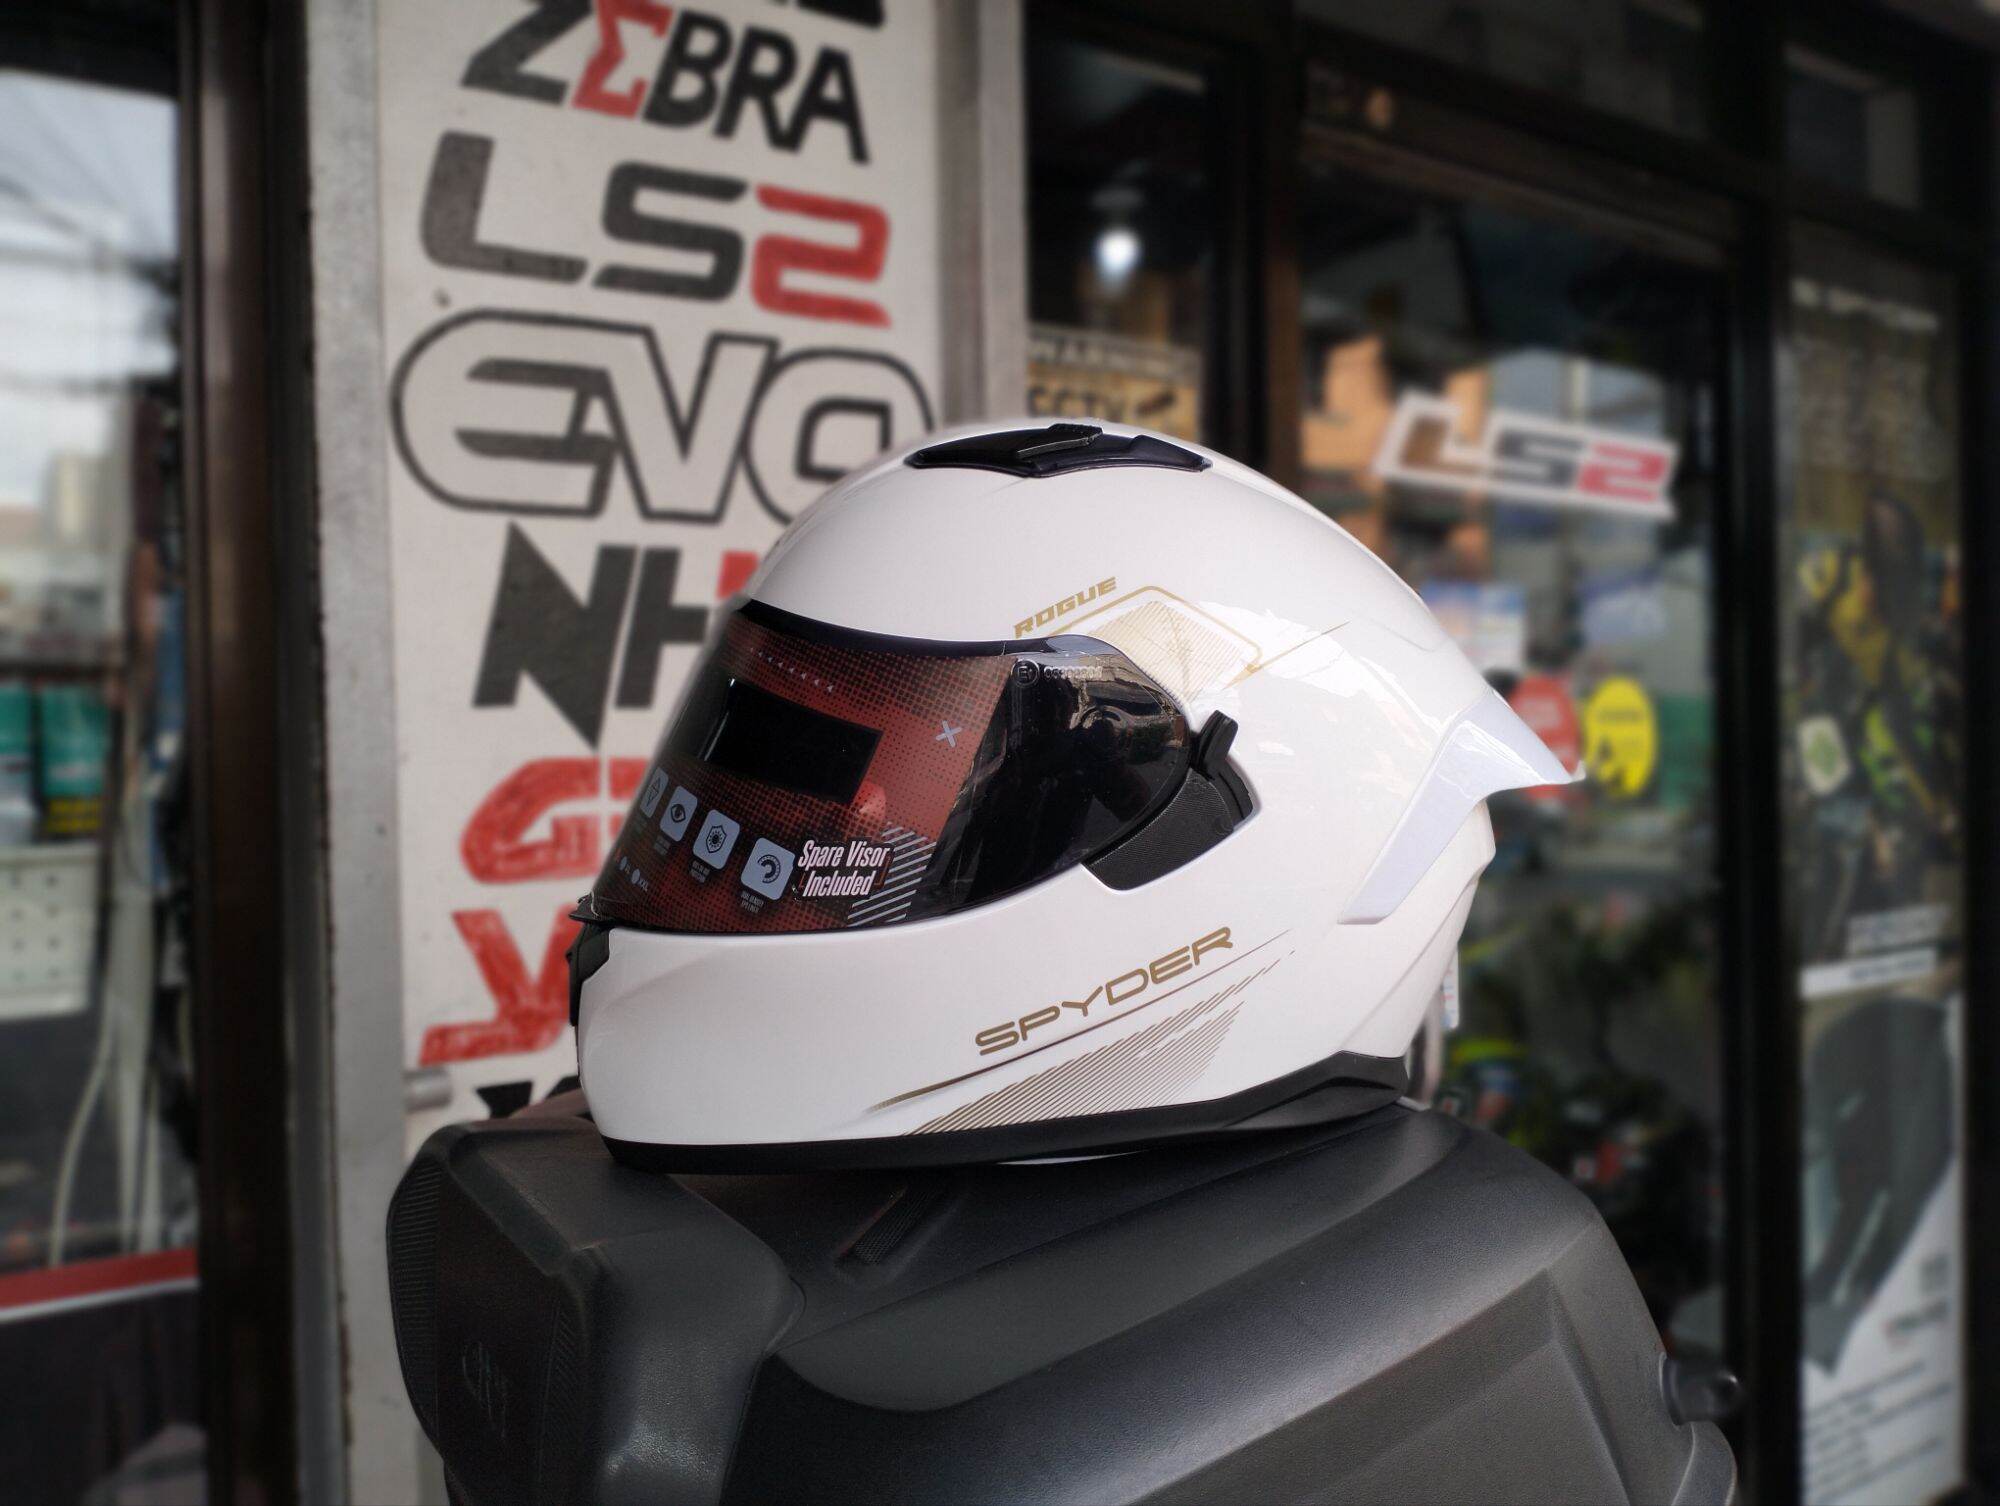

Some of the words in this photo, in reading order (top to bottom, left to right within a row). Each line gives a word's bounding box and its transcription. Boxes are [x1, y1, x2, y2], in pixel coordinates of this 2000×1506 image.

[420, 130, 892, 328] LS2
[391, 308, 935, 526] EVO
[1388, 402, 1675, 510] LS2
[471, 521, 762, 751] NH
[1014, 577, 1116, 638] ROGUE
[797, 840, 845, 871] Spare
[846, 840, 890, 868] Visor
[802, 870, 876, 897] Included
[975, 926, 1234, 1056] SPYDER
